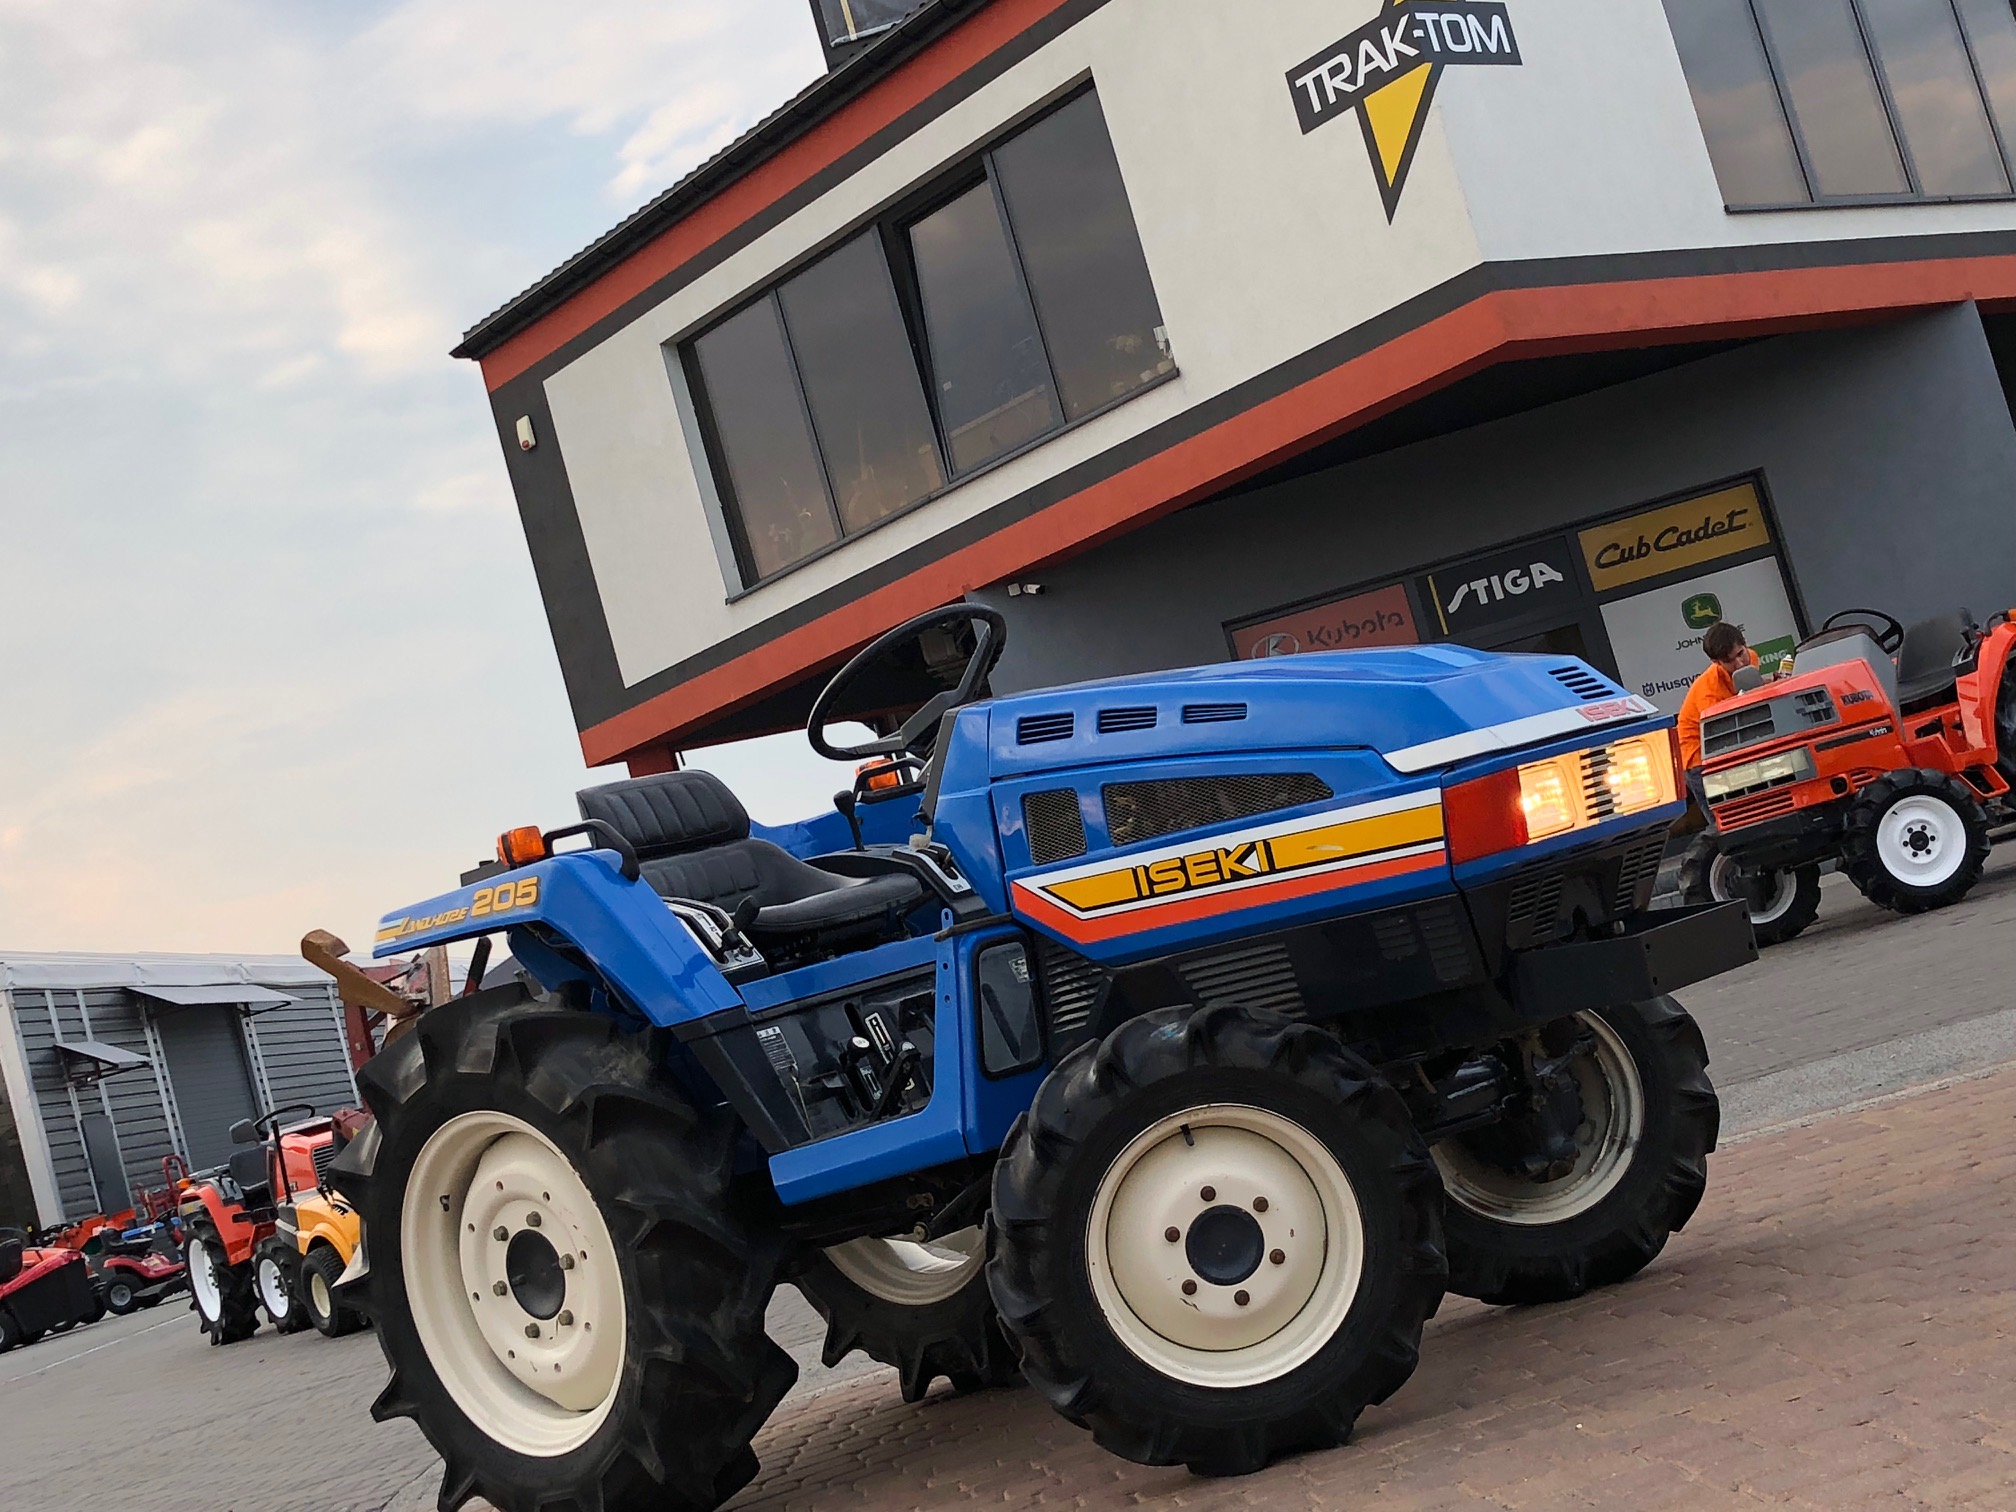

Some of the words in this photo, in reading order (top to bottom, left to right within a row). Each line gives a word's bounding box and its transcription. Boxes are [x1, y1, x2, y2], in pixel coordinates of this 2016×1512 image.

[1295, 12, 1512, 113] TRAK-TOM
[1595, 535, 1651, 569] Cub
[1653, 508, 1749, 552] Cadet
[1447, 562, 1564, 614] STIGA
[1306, 610, 1405, 646] Kubota
[1759, 649, 1787, 666] KING
[1655, 673, 1702, 693] Husqv
[1575, 698, 1647, 722] ISEKI
[1136, 840, 1270, 897] ISEKI
[471, 876, 540, 917] 205
